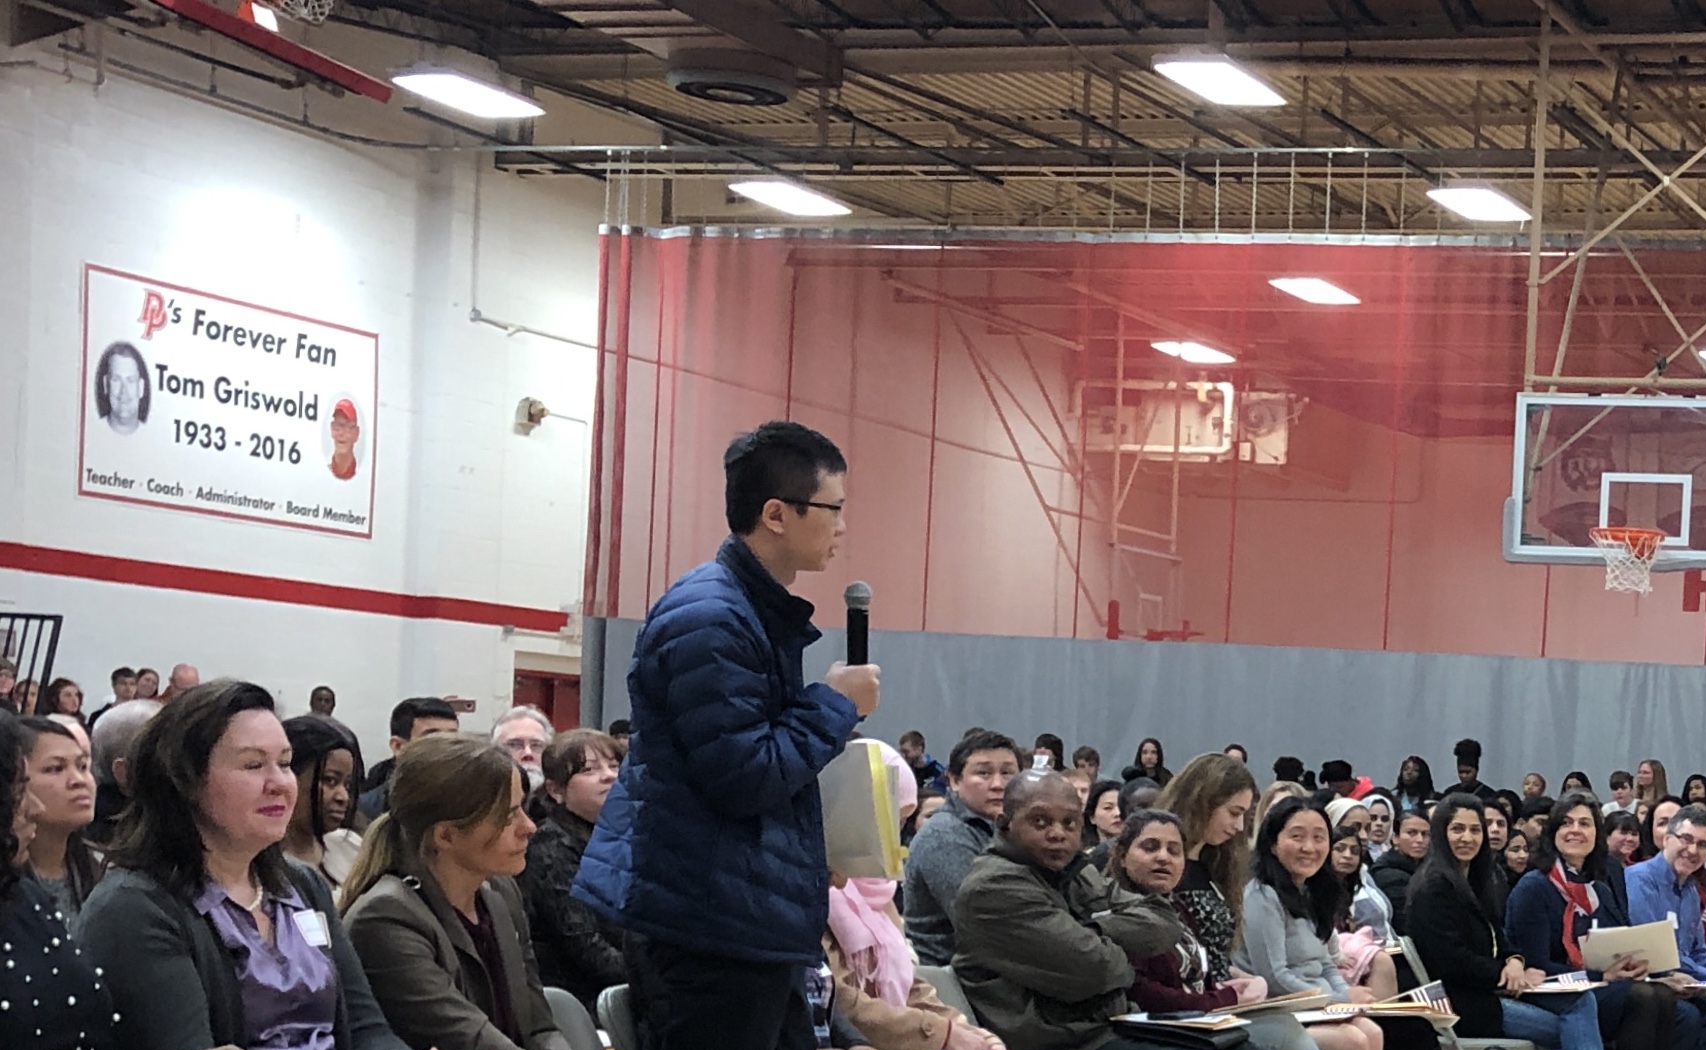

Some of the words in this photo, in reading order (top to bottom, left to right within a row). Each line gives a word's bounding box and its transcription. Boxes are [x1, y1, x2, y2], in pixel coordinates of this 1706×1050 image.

[193, 308, 287, 356] Forever
[296, 333, 337, 367] Fan
[155, 364, 204, 399] Tom
[214, 376, 319, 421] Griswold
[173, 419, 227, 451] 1933
[250, 433, 301, 465] 2016
[86, 468, 135, 490] Teacher
[147, 478, 184, 498] Coach
[196, 487, 276, 512] Administrator
[286, 500, 320, 520] Board
[322, 507, 367, 526] Member
